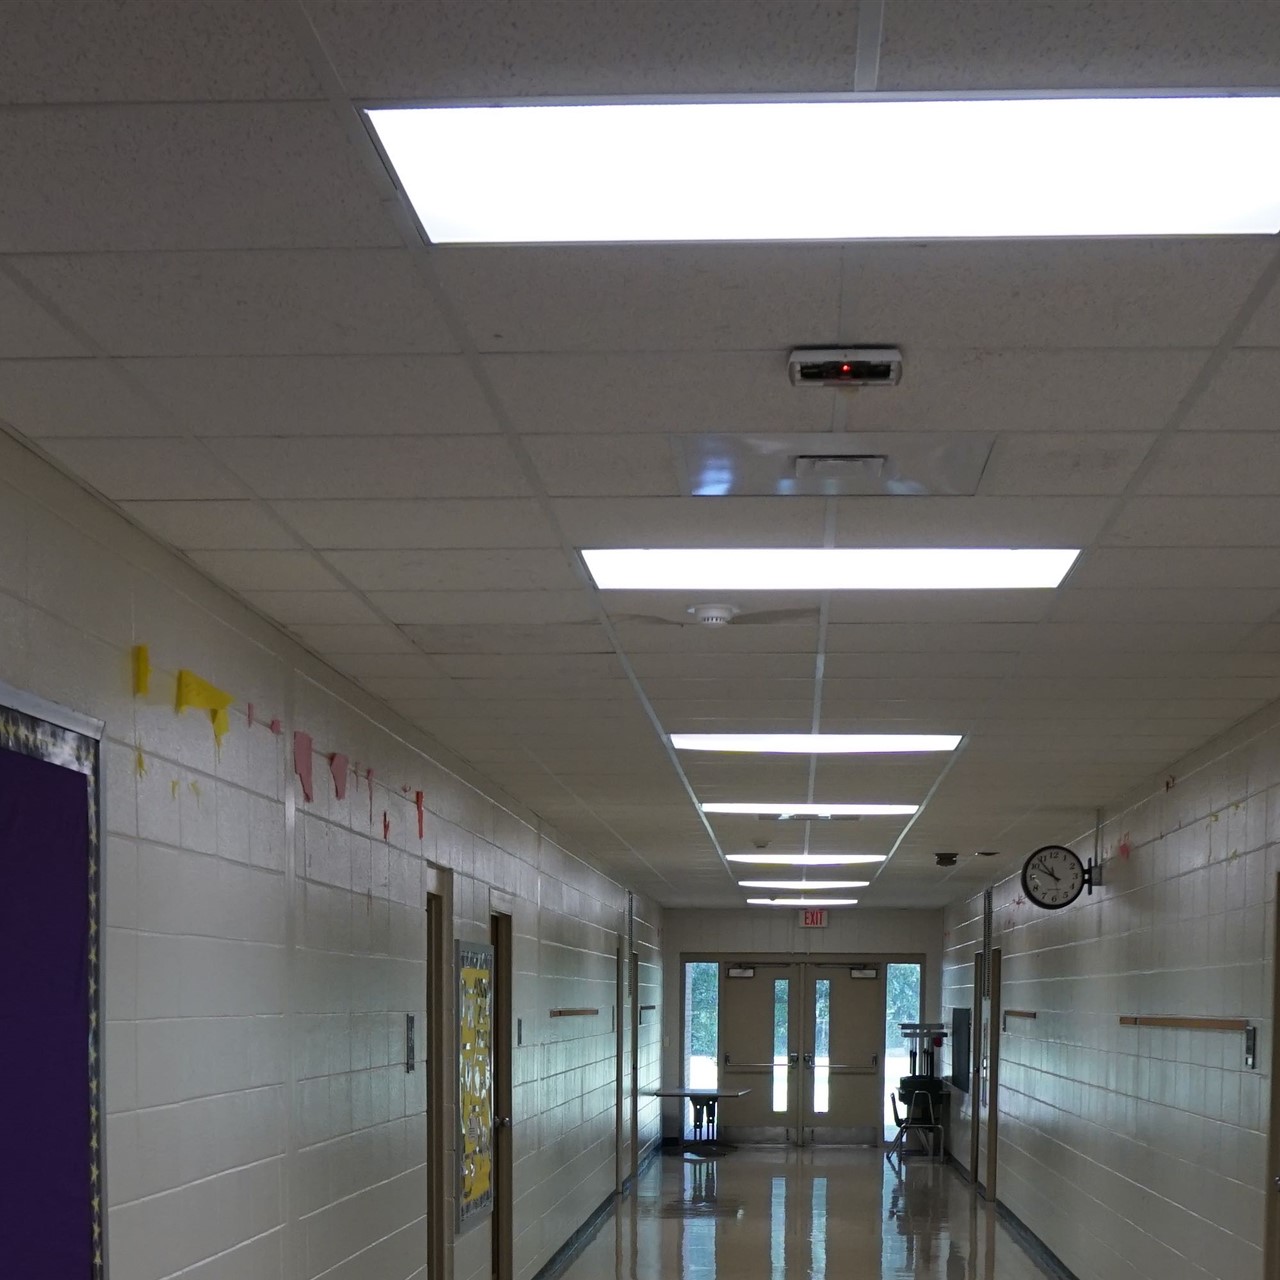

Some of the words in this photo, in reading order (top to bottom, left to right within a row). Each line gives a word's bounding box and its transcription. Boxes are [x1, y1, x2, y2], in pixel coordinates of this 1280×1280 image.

[1049, 851, 1059, 859] 12
[1032, 884, 1039, 892] 8
[1051, 895, 1057, 903] 6
[804, 911, 824, 926] EXIT
